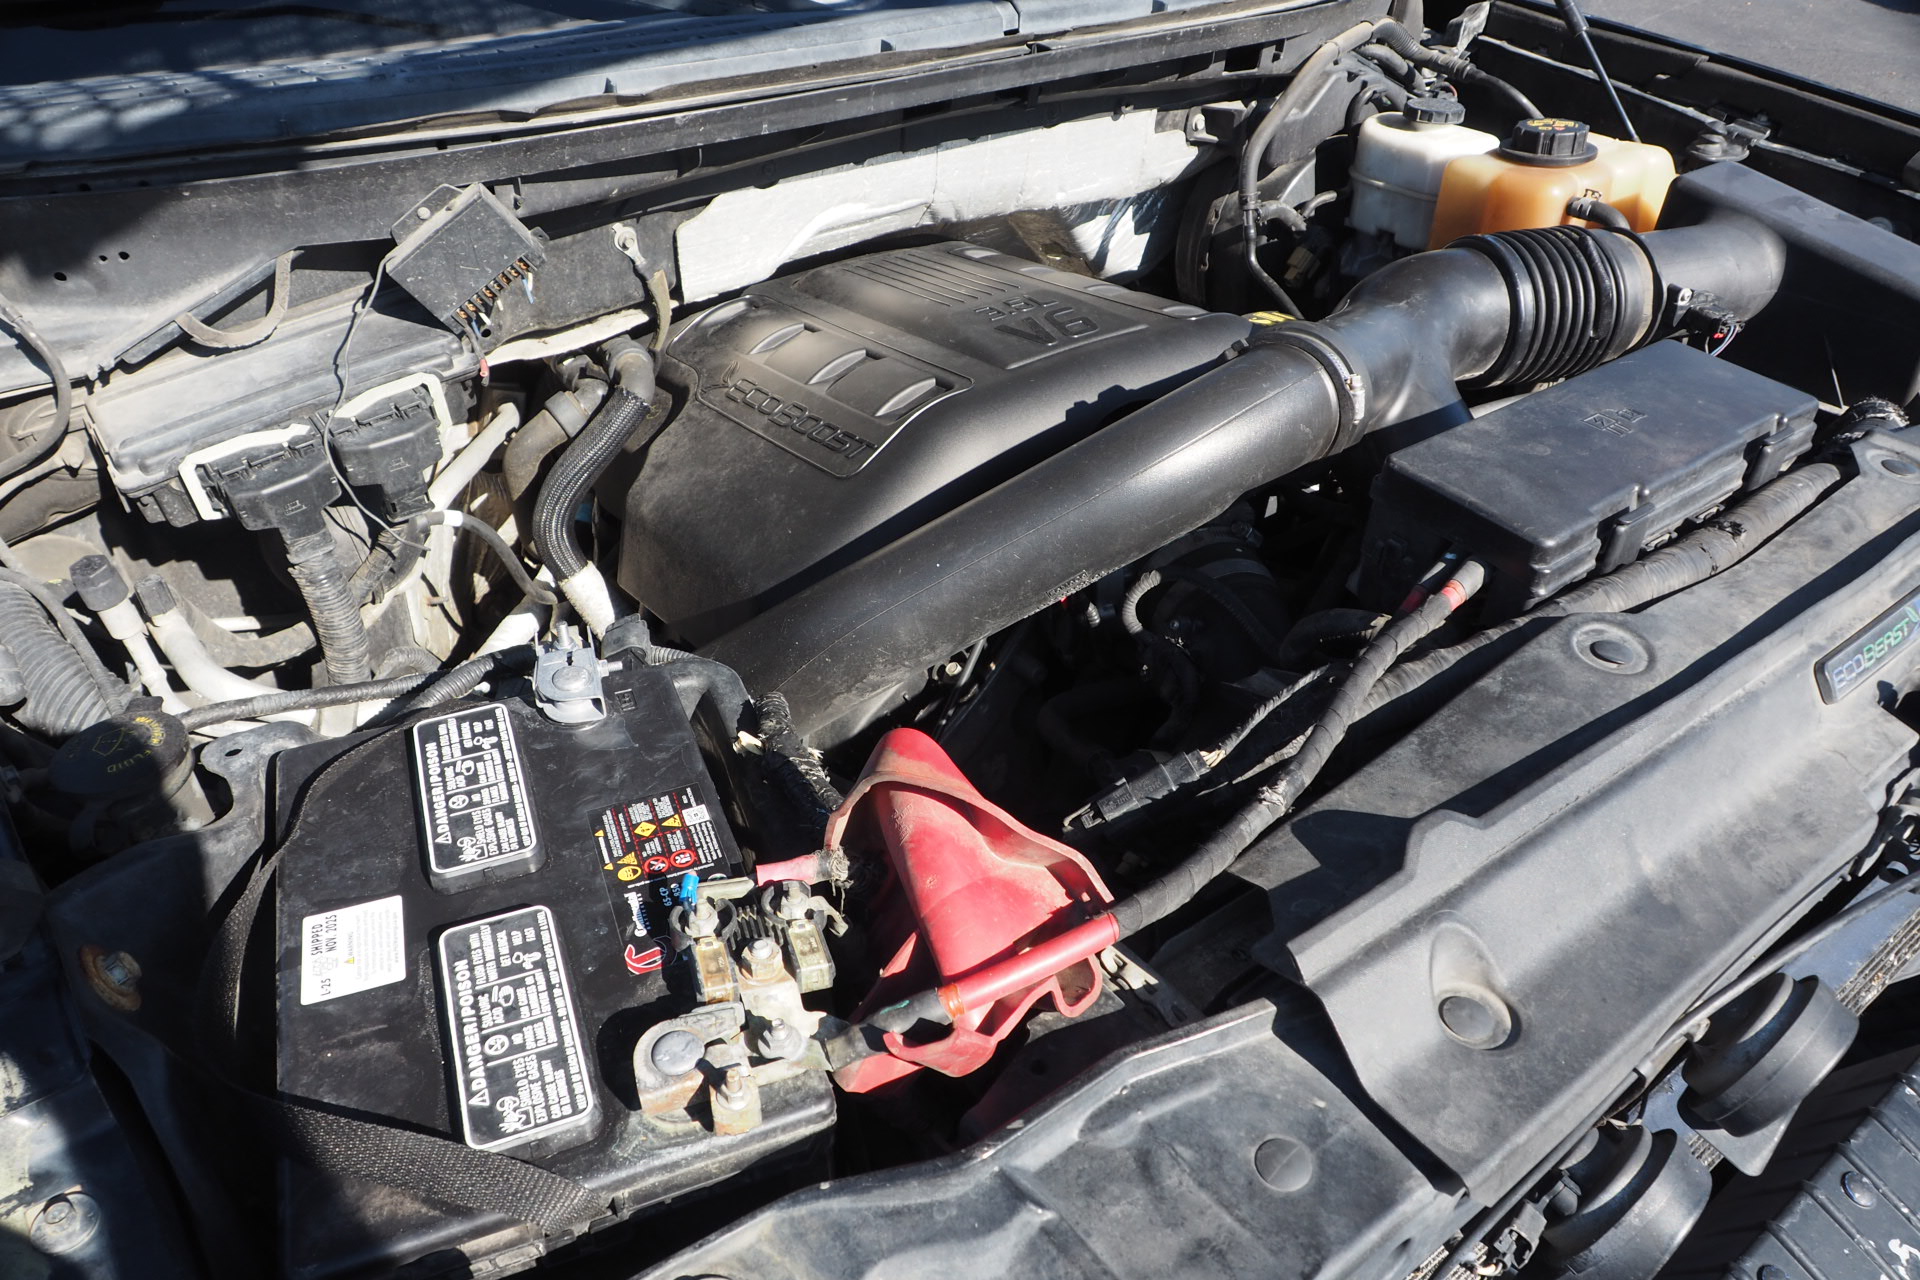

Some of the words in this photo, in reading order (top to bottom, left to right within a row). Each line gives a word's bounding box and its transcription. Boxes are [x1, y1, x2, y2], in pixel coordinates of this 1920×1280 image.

[994, 306, 1099, 346] V6
[1832, 617, 1910, 689] ECOBEAST
[425, 742, 449, 833] DANGER/POISON
[471, 810, 482, 824] EYES
[481, 808, 493, 826] GASES
[659, 887, 672, 906] 65-CP
[325, 914, 336, 933] 2025
[623, 891, 647, 937] Continental
[311, 924, 322, 955] SHIPPED
[325, 934, 336, 952] NOV.
[469, 933, 480, 949] WITH
[511, 930, 522, 945] HELP
[524, 927, 535, 941] FAST
[471, 948, 483, 964] EYES
[500, 955, 511, 966] GET
[474, 964, 486, 984] FLUSH
[516, 987, 528, 1005] CAUSE
[477, 993, 494, 1028] SULFURIC
[492, 1006, 504, 1023] ACID
[520, 1006, 530, 1018] CAN
[453, 959, 487, 1091] DANGER/POISON
[533, 1021, 546, 1046] FLAMES
[511, 1033, 523, 1044] NO
[512, 1057, 526, 1078] EYES
[524, 1054, 539, 1080] GASES
[516, 1078, 532, 1107] SHIELD
[529, 1080, 548, 1123] EXPLOSIVE
[545, 1082, 559, 1104] CAUSE
[550, 1103, 562, 1118] CAN
